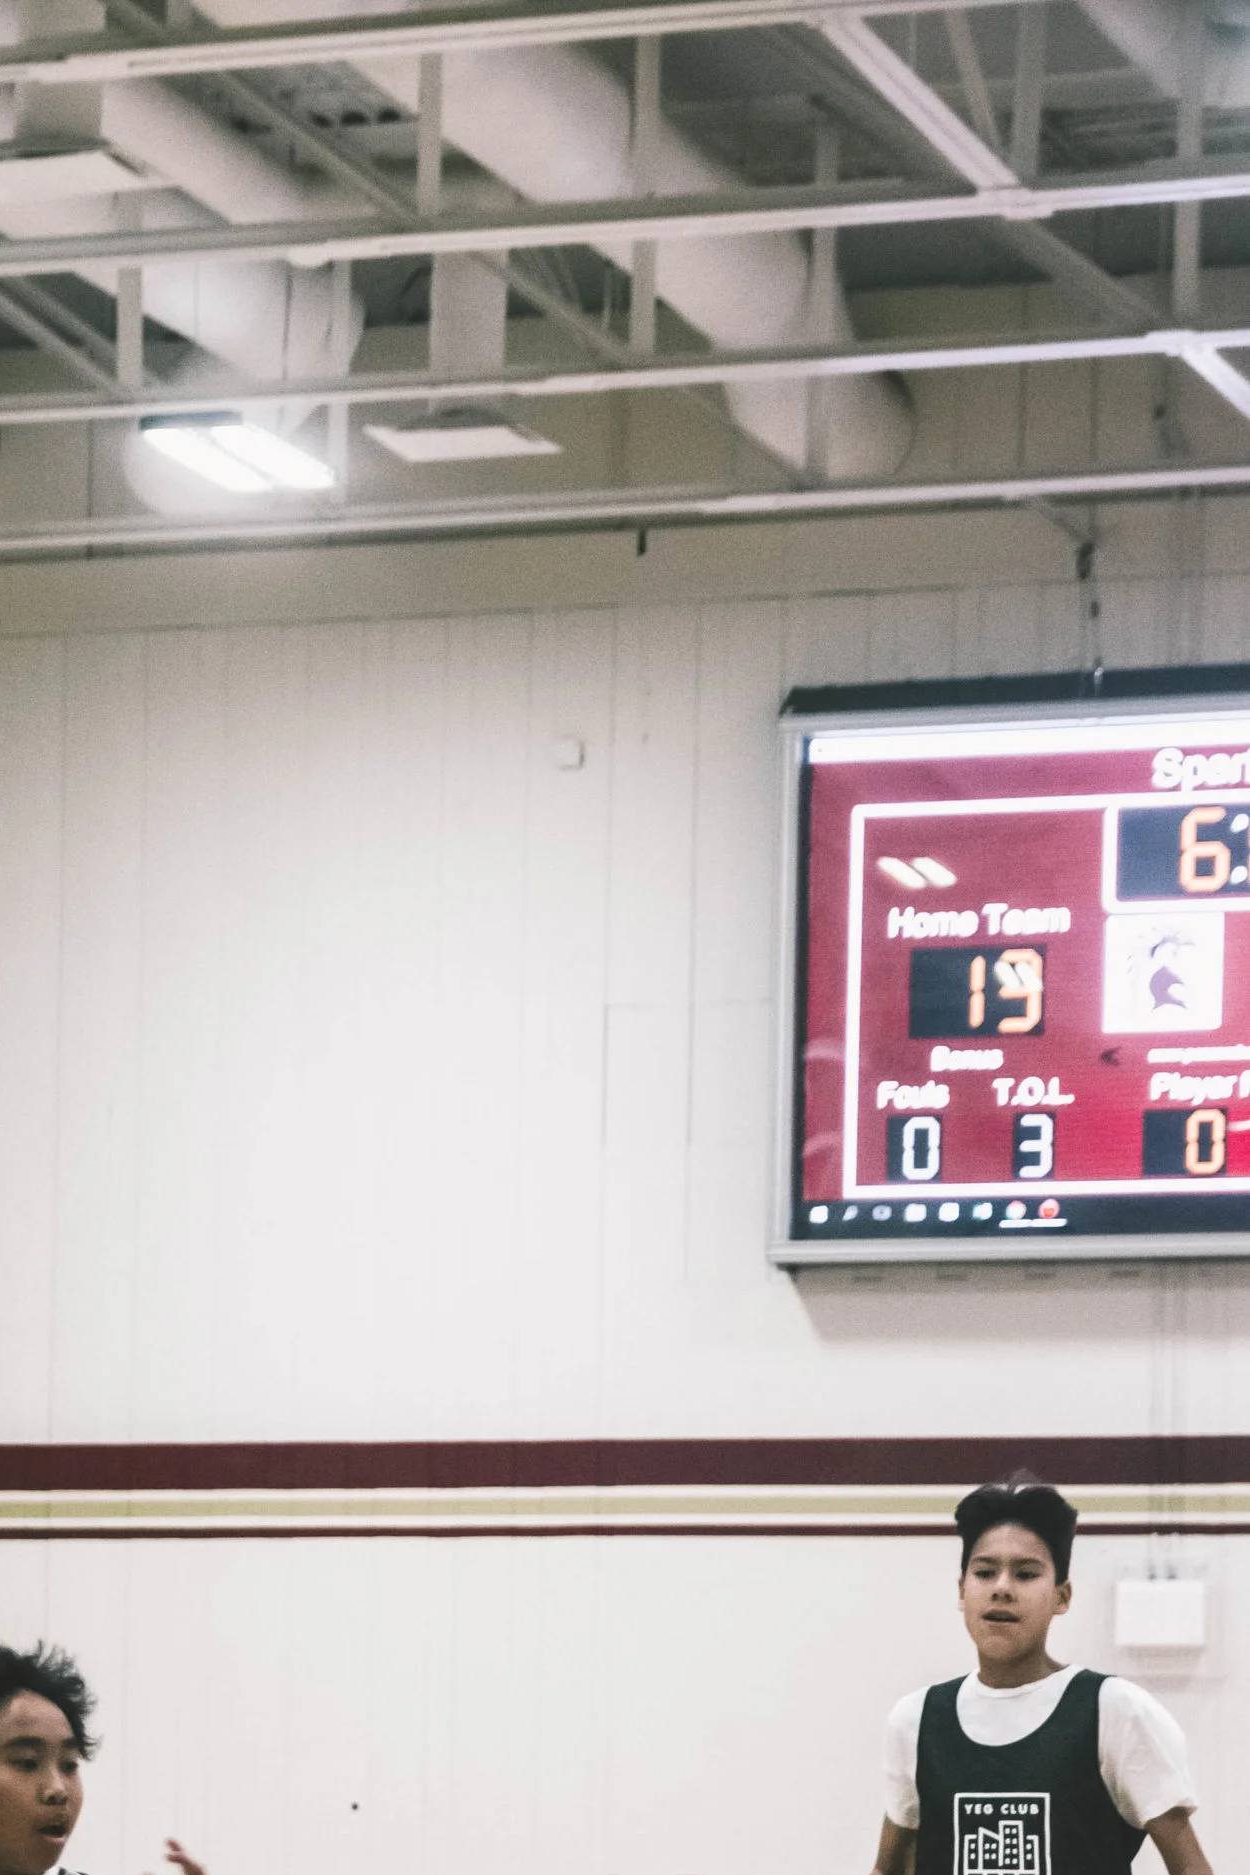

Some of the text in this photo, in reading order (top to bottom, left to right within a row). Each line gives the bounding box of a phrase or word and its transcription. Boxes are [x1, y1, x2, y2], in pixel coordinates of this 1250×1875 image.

[887, 903, 1072, 939] Home Team
[930, 1045, 1004, 1072] Bonus
[876, 1080, 950, 1110] Fouls
[902, 1108, 1226, 1180] 0 3 0
[1000, 1803, 1039, 1815] CLUB
